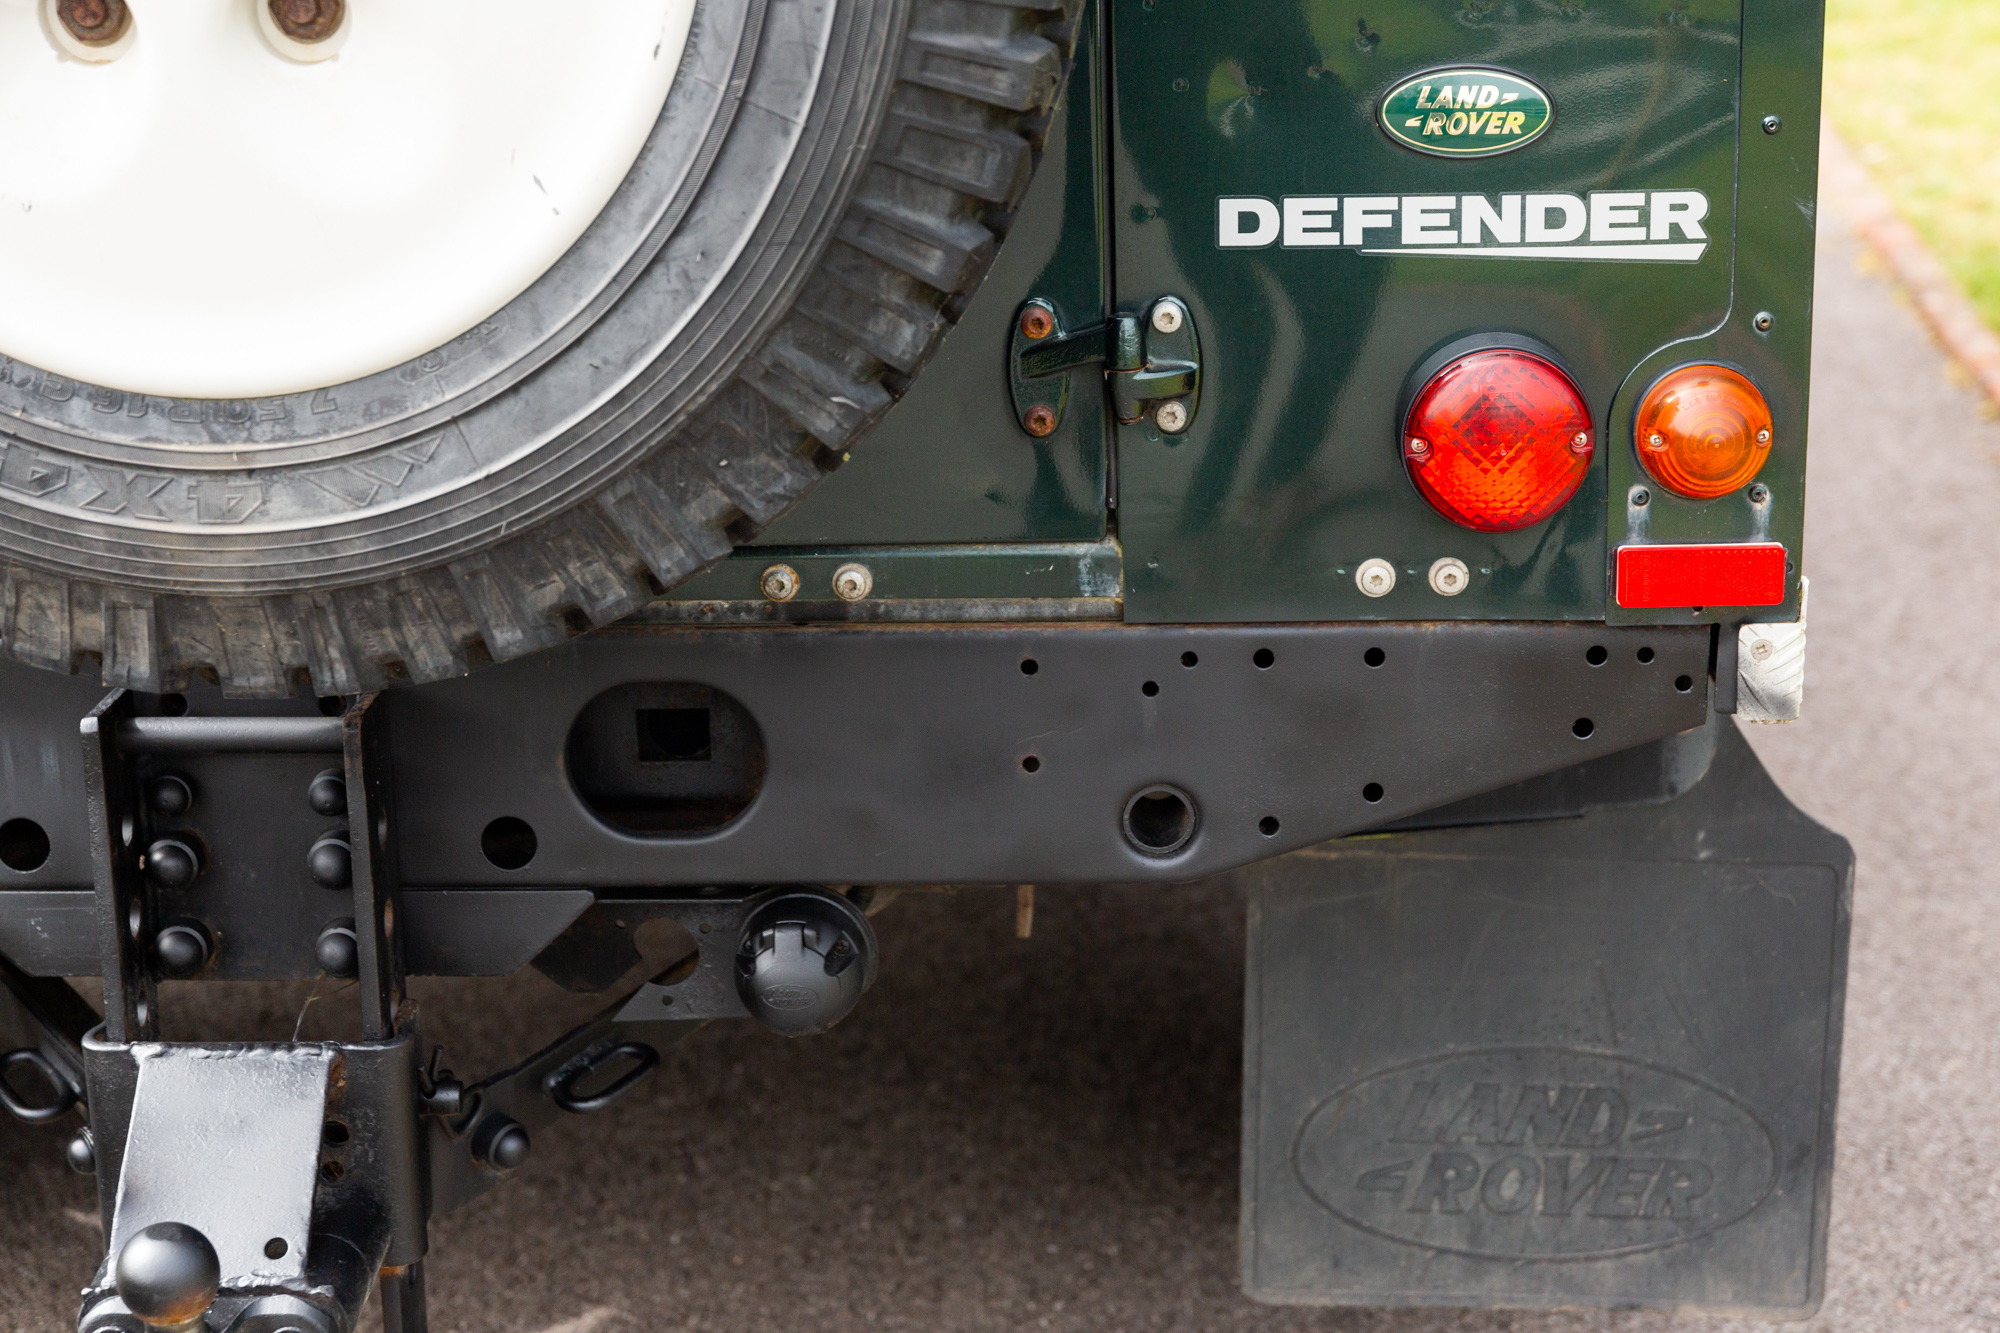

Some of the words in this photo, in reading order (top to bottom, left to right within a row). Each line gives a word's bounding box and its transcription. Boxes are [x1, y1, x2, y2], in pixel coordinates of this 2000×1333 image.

[1415, 85, 1499, 110] LAND
[1422, 111, 1526, 136] ROVER
[1218, 191, 1708, 248] DEFENDER
[1387, 1081, 1630, 1148] LAND
[1406, 1151, 1714, 1219] ROVER
